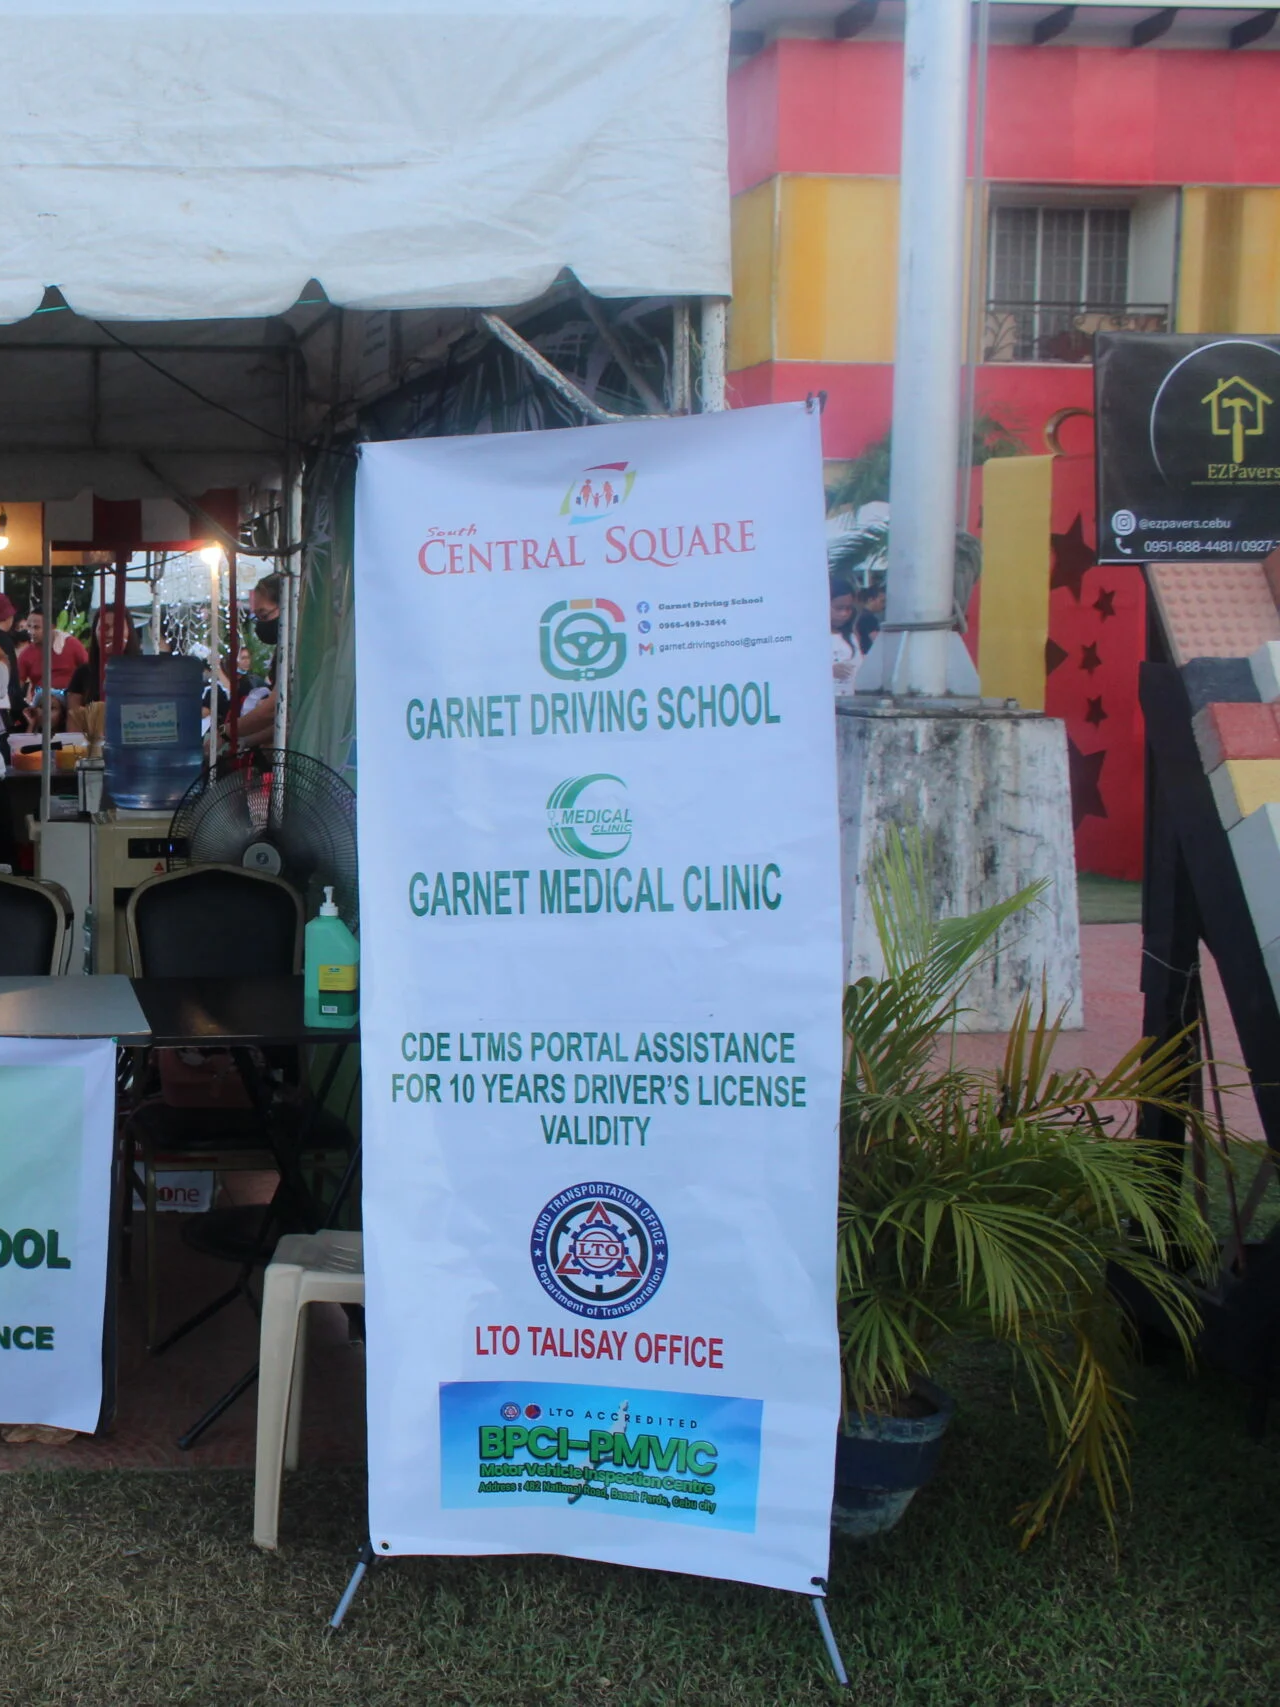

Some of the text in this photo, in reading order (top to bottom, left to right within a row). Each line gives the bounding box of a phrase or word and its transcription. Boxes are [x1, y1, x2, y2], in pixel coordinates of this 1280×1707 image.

[426, 523, 477, 537] South
[1139, 517, 1231, 531] @ezpavers.cebu
[658, 596, 763, 611] Garnet Driving School
[406, 681, 781, 741] GARNET DRIVING SCHOOL
[561, 808, 633, 825] MEDICAL
[591, 824, 632, 833] CLINIC
[408, 863, 782, 917] GARNET MEDICAL CLINIC
[401, 1032, 796, 1064] CDE LTMS PORTAL ASSISTANCE
[391, 1073, 807, 1107] FOR 10 YEARS DRIVER'S LICENSE
[540, 1115, 651, 1146] VALIDITY
[534, 1184, 665, 1246] LAND TRANSPORTATION OFFICE
[579, 1243, 620, 1257] LTO
[537, 1263, 663, 1317] Department of Transportation
[476, 1325, 724, 1369] LTO TALISAY OFFICE
[549, 1408, 697, 1429] LTO ACCREDITED
[479, 1425, 717, 1476] BPCI-PMVIC
[480, 1463, 715, 1495] Motor Vehicle Inspection Centre
[478, 1481, 516, 1493] Address
[523, 1481, 541, 1492] 482
[543, 1481, 581, 1495] National
[610, 1488, 639, 1502] Basak
[672, 1496, 697, 1510] Cebu
